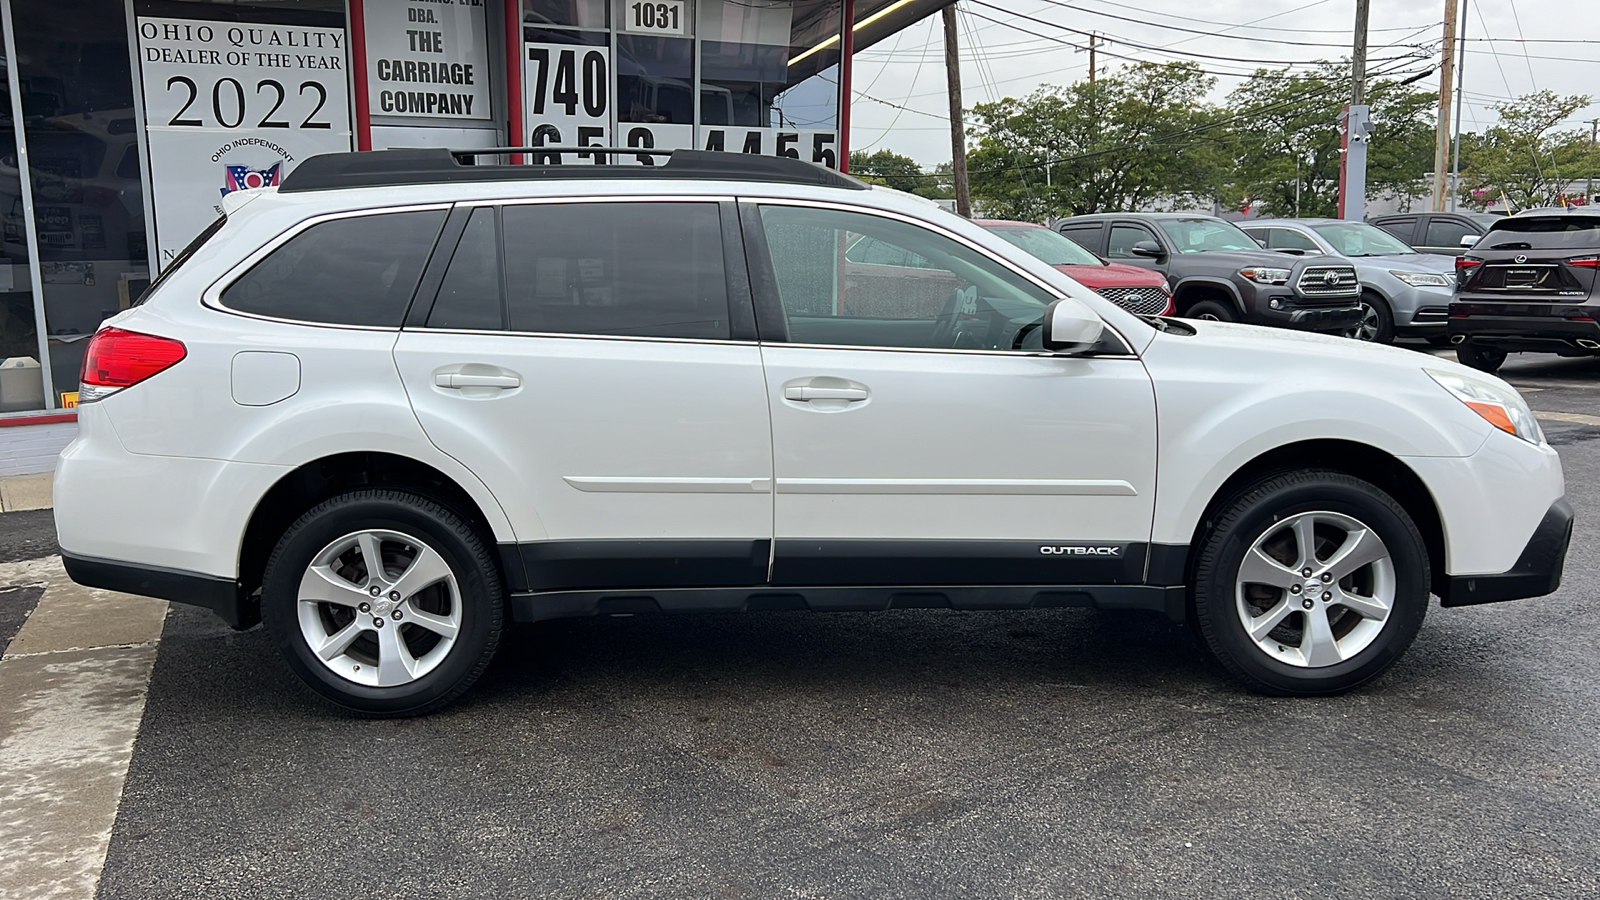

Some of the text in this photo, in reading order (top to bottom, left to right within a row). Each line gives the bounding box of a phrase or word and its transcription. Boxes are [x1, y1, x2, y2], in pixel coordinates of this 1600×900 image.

[407, 8, 438, 24] DBA.
[631, 2, 680, 30] 1031
[141, 22, 343, 49] OHIO QUALITY
[406, 30, 443, 53] THE
[146, 47, 342, 70] DEALER OF THE YEAR
[377, 59, 474, 85] CARRIAGE
[529, 48, 607, 118] 740
[167, 75, 331, 130] 2022
[380, 90, 474, 115] COMPANY
[211, 138, 295, 163] OHIO INDEPENDENT
[1040, 546, 1120, 556] OUTBACK
